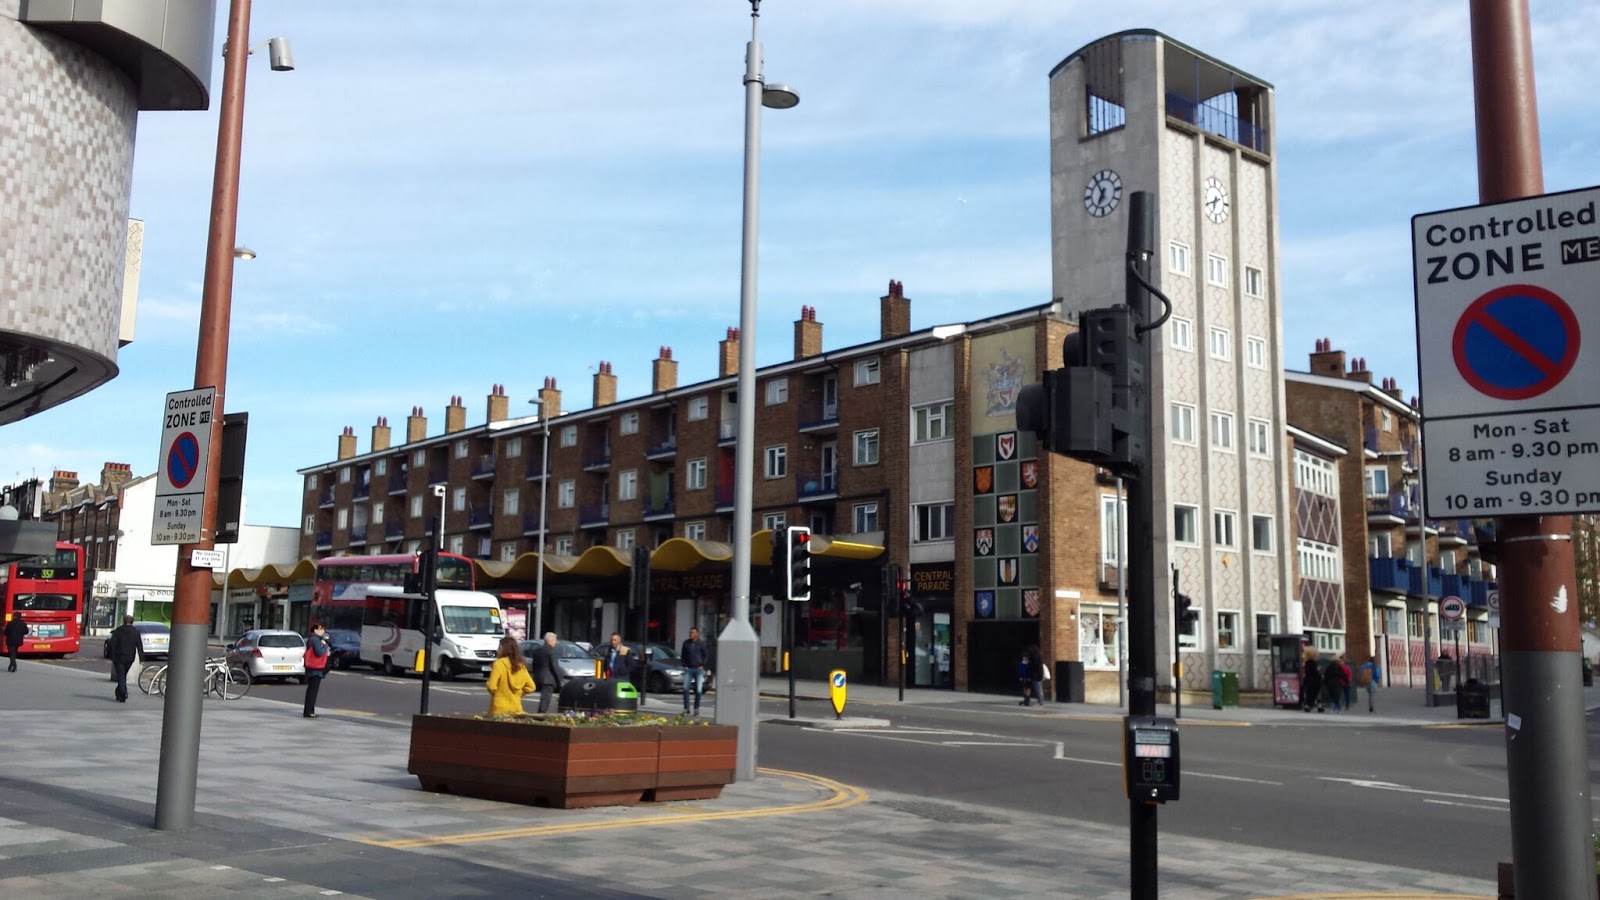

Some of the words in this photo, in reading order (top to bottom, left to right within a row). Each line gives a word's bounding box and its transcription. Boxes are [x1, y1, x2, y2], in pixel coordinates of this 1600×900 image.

[1426, 201, 1597, 247] Controlled
[1427, 242, 1544, 285] ZONE
[1562, 240, 1600, 264] ME
[168, 393, 212, 410] Controlled
[166, 412, 196, 428] ZONE
[1473, 424, 1516, 439] Mon
[1534, 418, 1570, 434] Sat
[1449, 447, 1461, 462] 8
[1466, 449, 1495, 462] am
[1512, 441, 1561, 458] 9.30
[1567, 442, 1599, 457] pm
[1486, 468, 1562, 486] Sunday
[167, 499, 178, 507] Mon
[181, 498, 191, 506] Sat
[1445, 494, 1468, 510] 10
[1474, 495, 1502, 508] am
[1520, 490, 1569, 506] 9.30
[175, 509, 188, 518] 9.30
[167, 522, 186, 530] Sunday
[41, 569, 54, 578] 357
[914, 570, 953, 581] CENTRAL
[917, 581, 950, 591] PARADE
